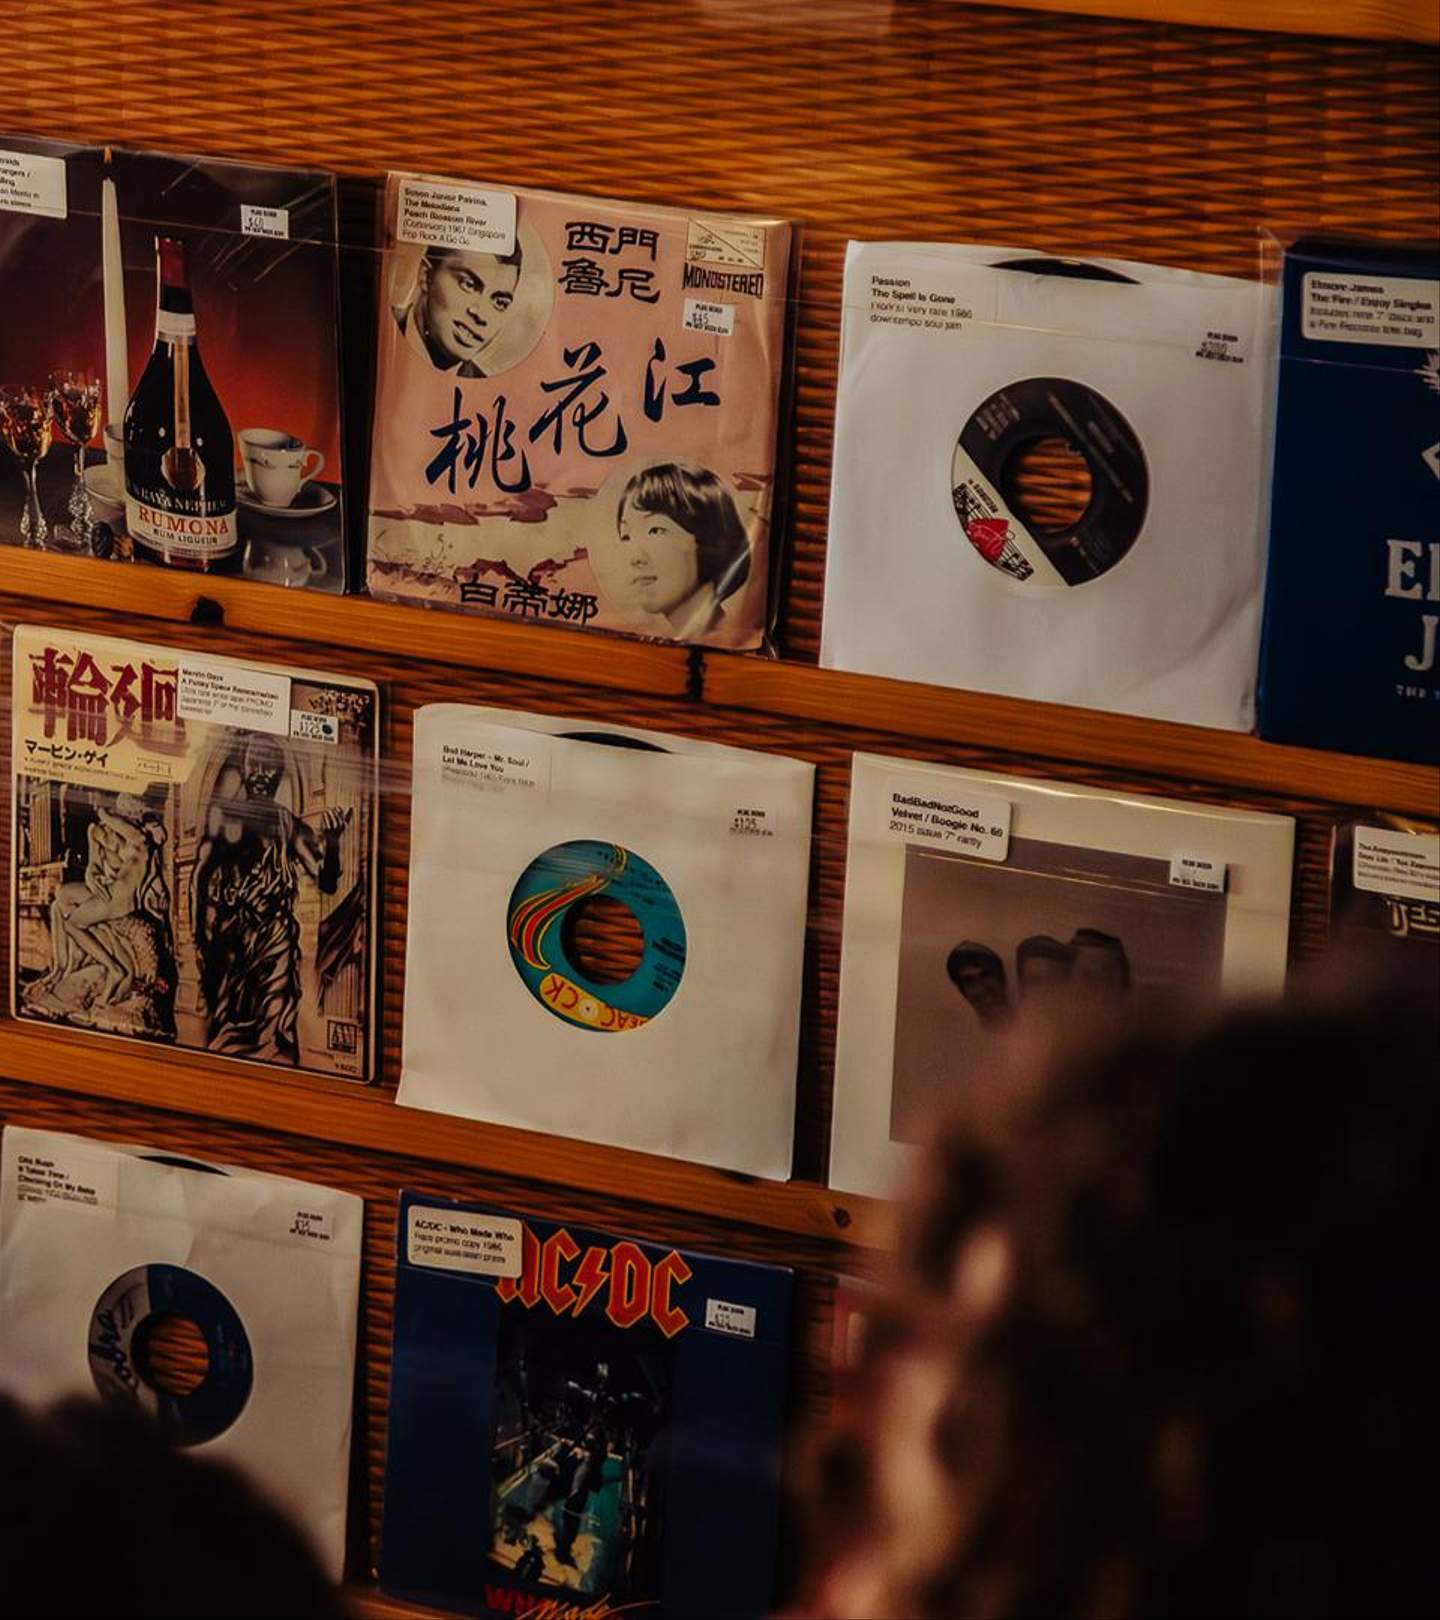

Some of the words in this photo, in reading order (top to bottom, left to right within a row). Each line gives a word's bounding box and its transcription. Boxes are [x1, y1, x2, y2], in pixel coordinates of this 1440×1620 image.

[405, 198, 419, 207] The
[404, 209, 428, 219] Peach
[430, 212, 464, 222] Blossom
[466, 215, 487, 226] River
[419, 233, 437, 242] Rock
[563, 220, 659, 262] 西門
[872, 275, 911, 288] Passion
[1311, 279, 1347, 292] Elmore
[1348, 283, 1384, 295] James
[871, 288, 890, 299] The
[891, 290, 916, 302] Spell
[918, 293, 927, 302] Is
[929, 293, 956, 304] Gone
[1311, 292, 1330, 303] The
[1332, 294, 1351, 305] Fire
[1394, 299, 1431, 311] Singles
[908, 306, 927, 316] very
[929, 308, 948, 316] rare
[871, 313, 922, 328] downtempo
[425, 335, 720, 494] 桃花江
[138, 505, 229, 536] RUMONA
[178, 534, 218, 545] LIQUEUR
[182, 669, 205, 679] Marvin
[181, 677, 187, 685] A
[188, 679, 210, 689] Funky
[211, 682, 231, 693] Space
[24, 738, 109, 769] マービン・ゲイ
[443, 745, 458, 755] Bud
[460, 747, 485, 760] Harper
[508, 757, 525, 767] Soul
[443, 755, 454, 764] Let
[457, 758, 467, 766] Me
[470, 760, 488, 770] Love
[490, 764, 504, 773] You
[892, 792, 979, 819] BadBadNotGood
[892, 806, 923, 822] Velvet
[931, 814, 968, 831] Boogie
[970, 822, 988, 835] No.
[889, 819, 915, 834] 2015
[957, 835, 983, 850] rarity
[415, 1219, 444, 1233] AC/DC
[450, 1225, 469, 1237] Who
[470, 1228, 493, 1239] Made
[495, 1231, 516, 1243] Who
[435, 1236, 461, 1248] promo
[462, 1239, 481, 1251] copy
